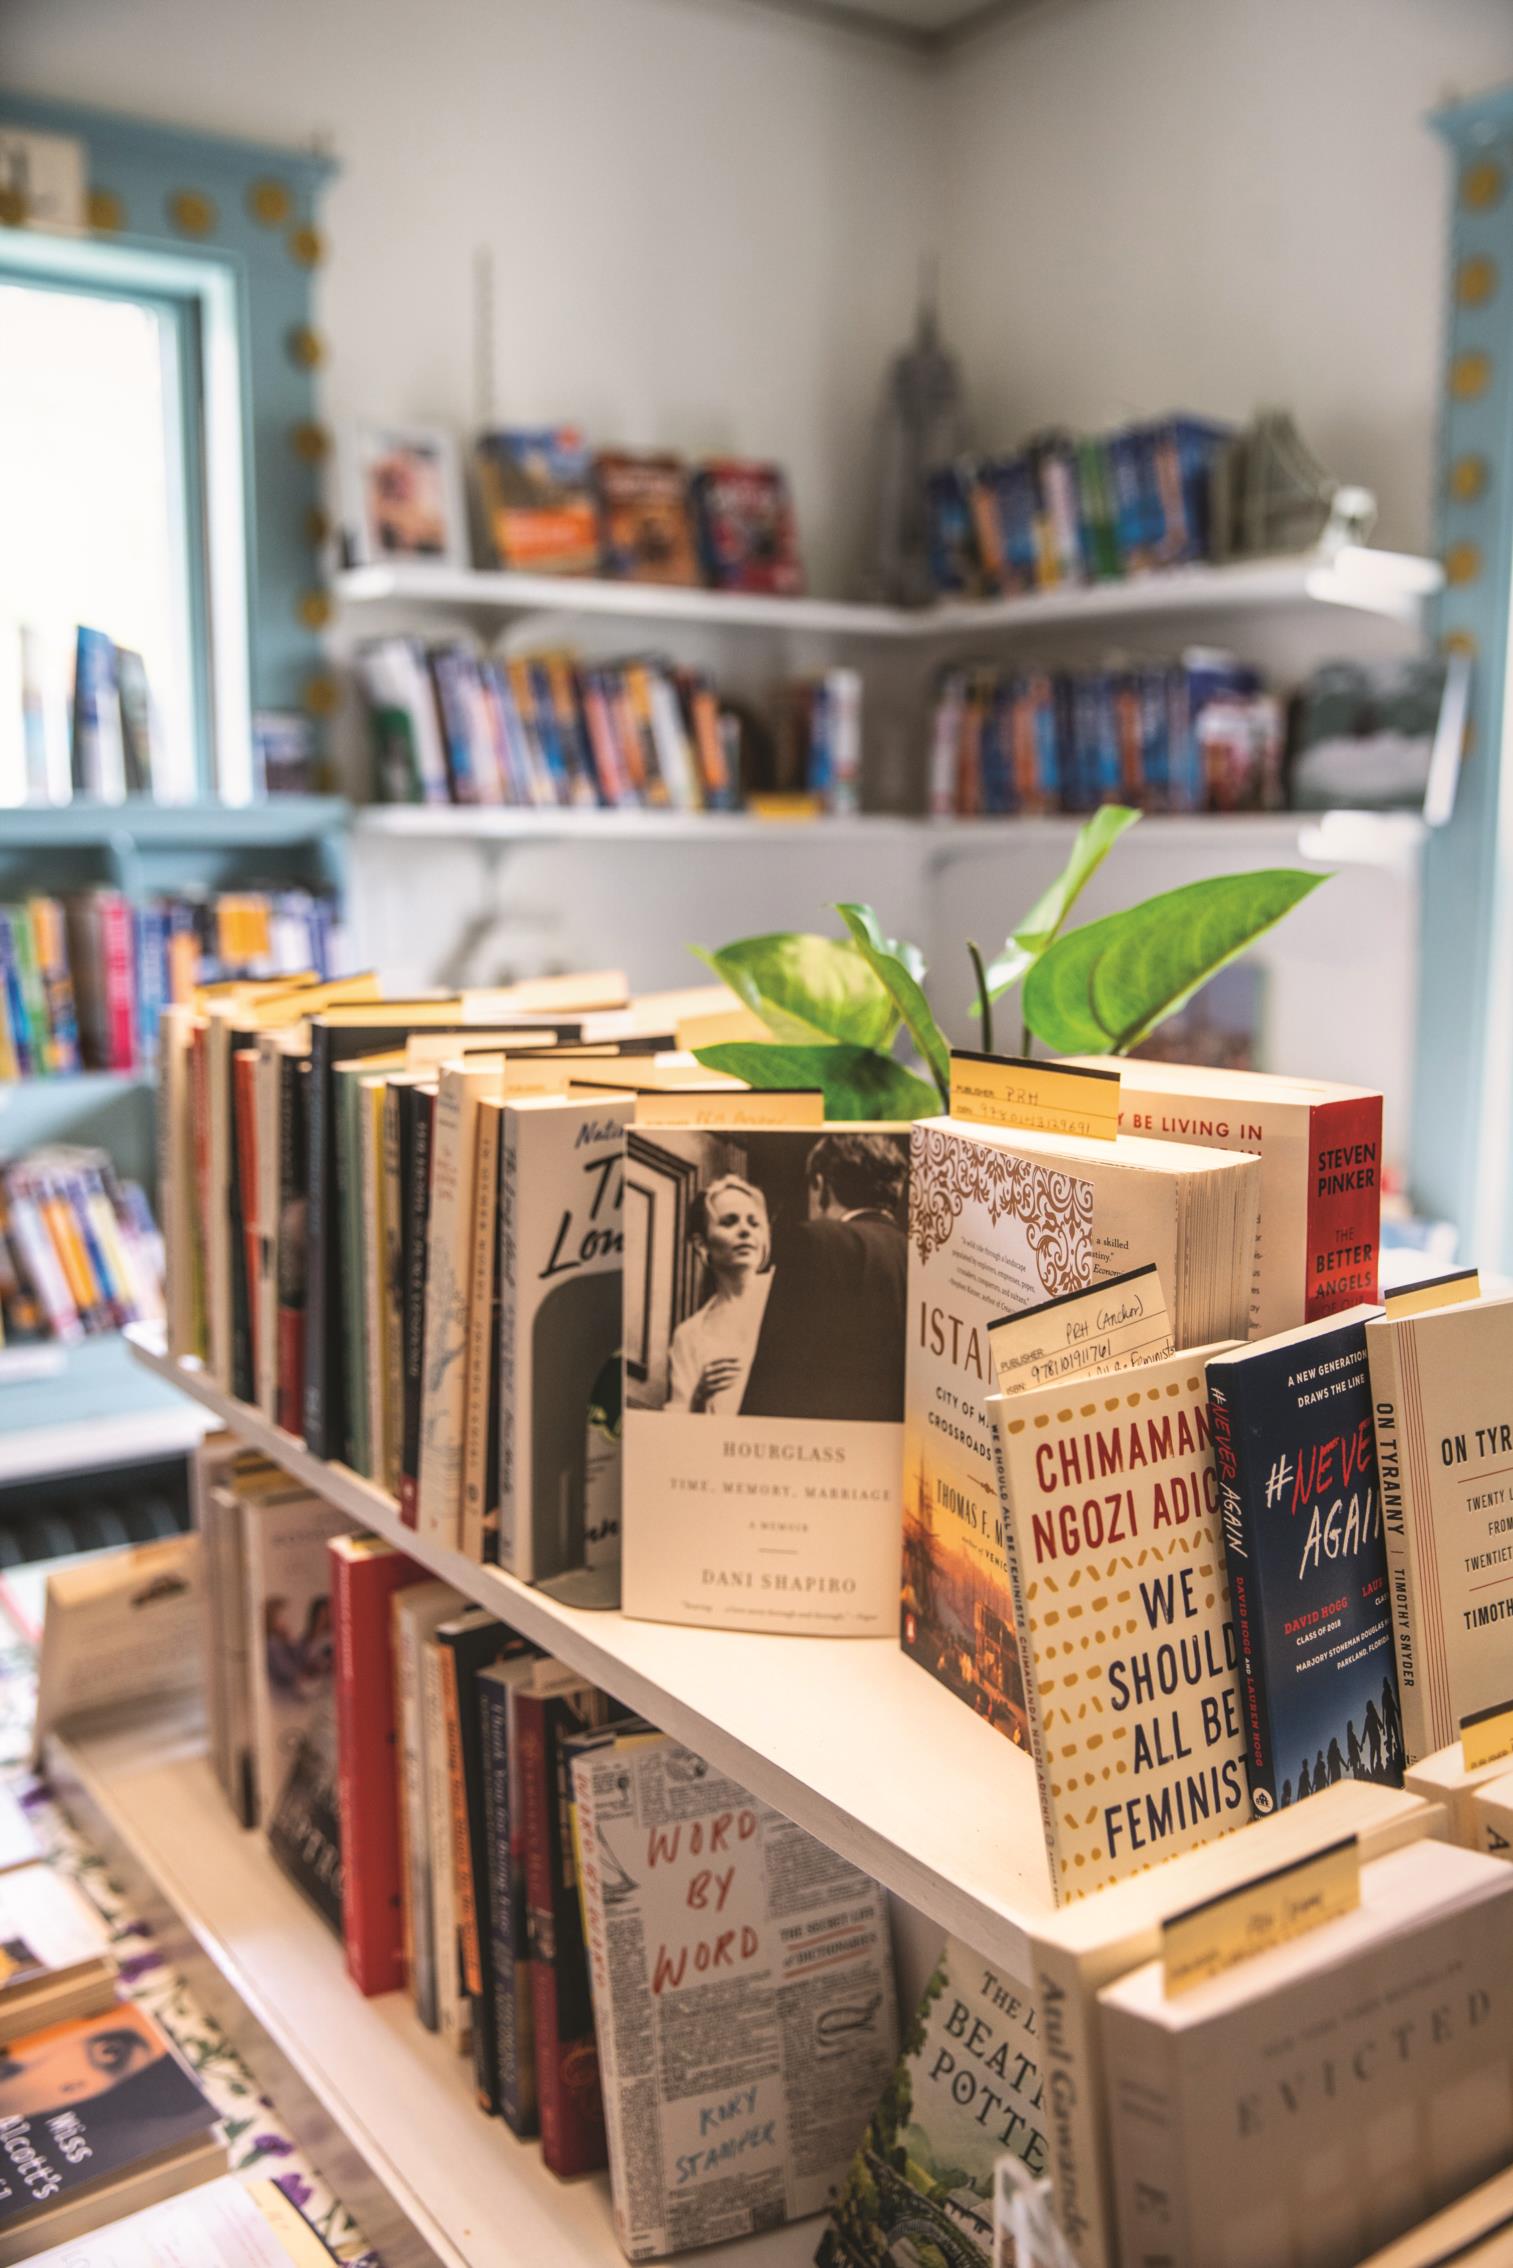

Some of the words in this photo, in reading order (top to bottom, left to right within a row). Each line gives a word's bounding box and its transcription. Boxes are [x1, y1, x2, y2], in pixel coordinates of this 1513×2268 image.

[1133, 1114, 1153, 1130] BE
[1162, 1116, 1230, 1138] LIVING
[1240, 1124, 1263, 1141] IN
[1318, 1142, 1377, 1172] STEVEN
[584, 1151, 625, 1221] T
[1317, 1168, 1375, 1198] PINKER
[1103, 1236, 1129, 1250] skilled
[1335, 1227, 1355, 1244] THE
[1316, 1244, 1373, 1274] BETTER
[1316, 1271, 1372, 1299] ANGELS
[920, 1301, 992, 1386] ISTA
[1000, 1348, 1044, 1371] PUBLISHER
[1065, 1322, 1089, 1344] PRH
[1288, 1375, 1295, 1388] A
[1296, 1368, 1316, 1385] NEW
[1318, 1349, 1367, 1377] GENERATION
[935, 1386, 958, 1410] CITY
[962, 1402, 975, 1419] OF
[1298, 1387, 1329, 1408] DRAWS
[1330, 1381, 1347, 1397] THE
[1348, 1373, 1366, 1389] LINE
[928, 1411, 992, 1462] CROSSROADS
[991, 1424, 1001, 1442] WE
[1210, 1387, 1236, 1484] #NEVER
[1376, 1403, 1396, 1429] ON
[722, 1441, 847, 1464] HOURGLASS
[1441, 1434, 1468, 1467] ON
[804, 1486, 892, 1502] MARRIAGE
[994, 1446, 1009, 1502] SHOULD
[1380, 1439, 1405, 1536] TYRANNY
[937, 1478, 977, 1529] THOMAS
[981, 1509, 990, 1539] F.
[1002, 1505, 1012, 1531] ALL
[1219, 1481, 1249, 1558] AGAIN
[1467, 1490, 1506, 1513] TWENTY
[1006, 1535, 1016, 1552] BE
[1031, 1489, 1138, 1564] NGOZI
[702, 1568, 753, 1587] DANI
[760, 1574, 857, 1595] SHAPIRO
[1008, 1556, 1026, 1629] FEMINISTS
[1139, 1567, 1199, 1630] WE
[1236, 1576, 1248, 1617] DAVID
[1394, 1569, 1410, 1627] TIMOTHY
[1284, 1610, 1319, 1635] DAVID
[1321, 1595, 1349, 1618] HOGG
[1296, 1630, 1317, 1646] CLASS
[1317, 1626, 1326, 1636] OF
[1327, 1619, 1342, 1632] 2018
[1240, 1619, 1253, 1655] HOGG
[1296, 1651, 1328, 1673] MARJORY
[1329, 1634, 1360, 1658] STONEMAN
[1361, 1621, 1385, 1640] DOUGLAS
[1019, 1636, 1038, 1724] CHIMAMANDA
[1108, 1621, 1239, 1711] SHOULD
[1244, 1657, 1252, 1675] AND
[1337, 1649, 1369, 1670] PARKLAND,
[1400, 1634, 1415, 1687] SNYDER
[1247, 1677, 1260, 1729] LAUREN
[1134, 1710, 1192, 1774] ALL
[1201, 1688, 1240, 1747] BE
[1253, 1732, 1265, 1768] HOGG
[1037, 1773, 1052, 1829] ADICHIE
[647, 1809, 757, 1868] WORD
[686, 1866, 735, 1912] BY
[653, 1924, 759, 1996] WORD
[979, 1971, 1022, 2020] THE
[928, 2046, 1049, 2175] POTTE
[44, 2110, 93, 2164] Miss
